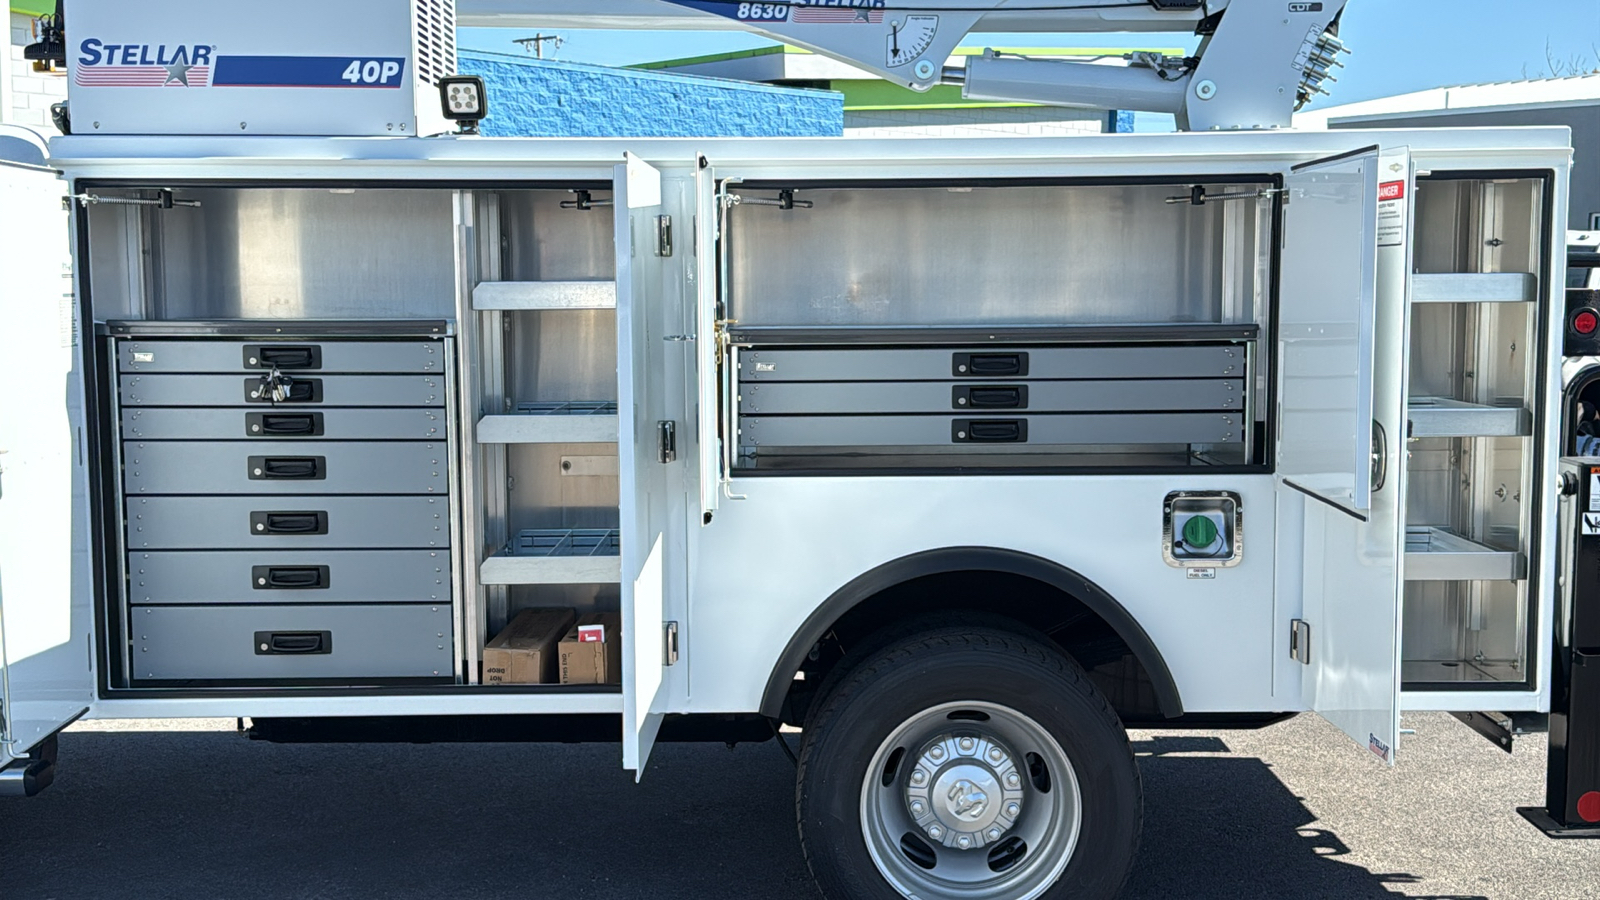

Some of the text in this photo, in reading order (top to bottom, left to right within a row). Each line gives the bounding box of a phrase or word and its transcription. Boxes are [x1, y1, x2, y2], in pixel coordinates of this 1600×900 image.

[737, 2, 788, 19] 8630
[1289, 3, 1312, 11] CDT
[78, 38, 212, 66] STELLAR
[342, 60, 400, 84] 40P
